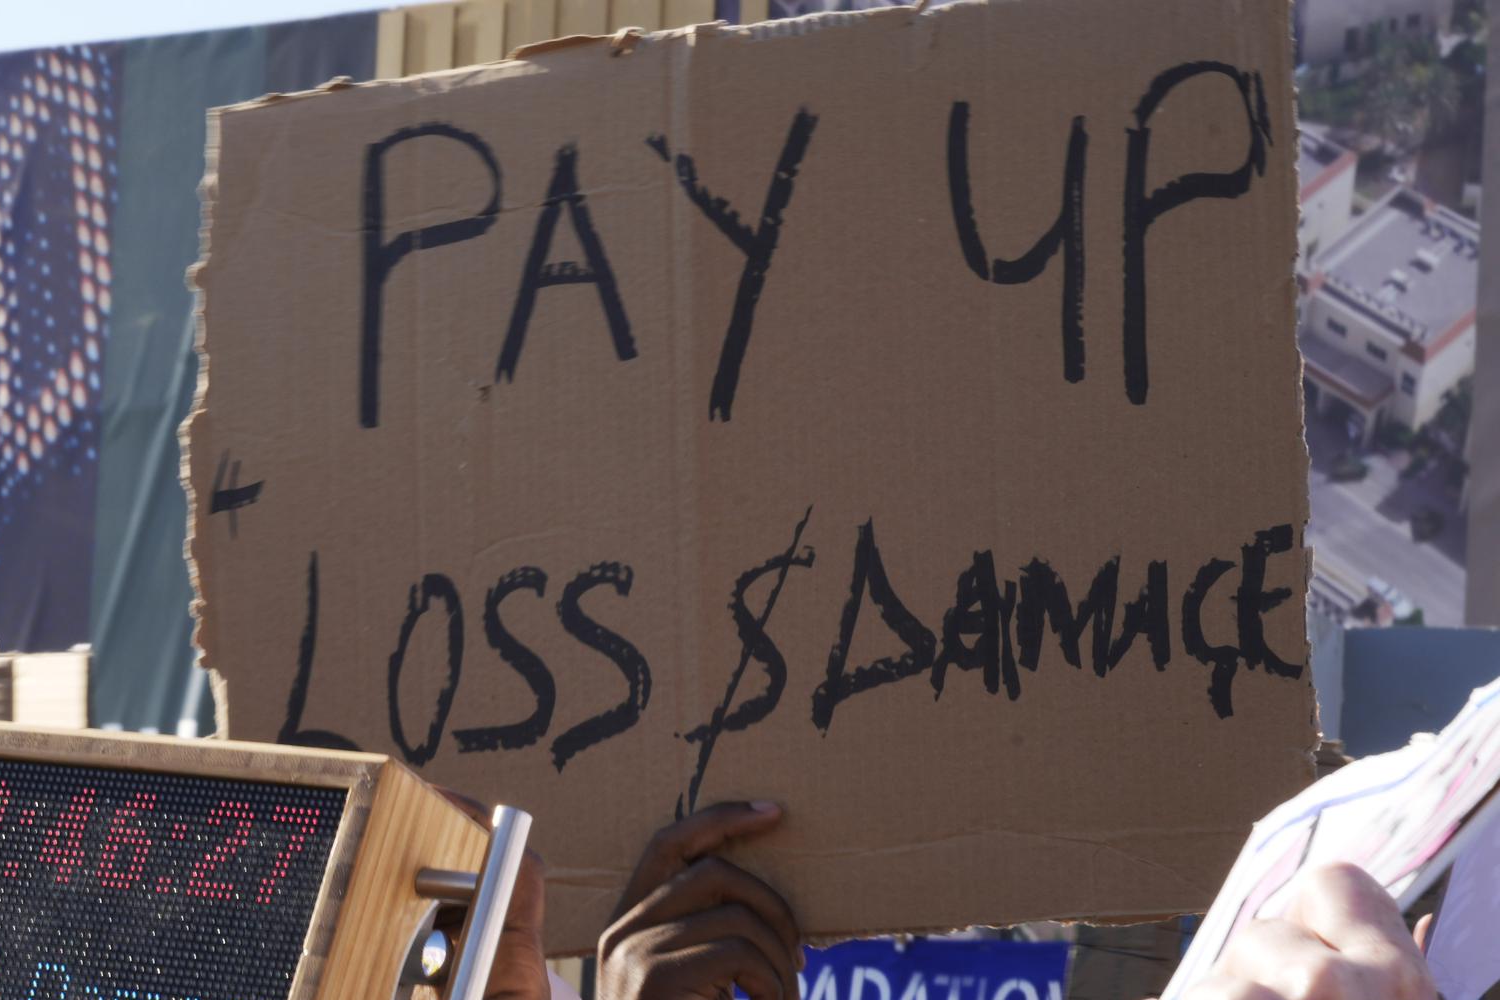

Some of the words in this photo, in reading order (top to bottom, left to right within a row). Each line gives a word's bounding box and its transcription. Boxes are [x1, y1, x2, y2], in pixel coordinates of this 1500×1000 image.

[360, 112, 818, 428] PAY
[946, 60, 1273, 406] UP
[278, 551, 653, 774] LOSS
